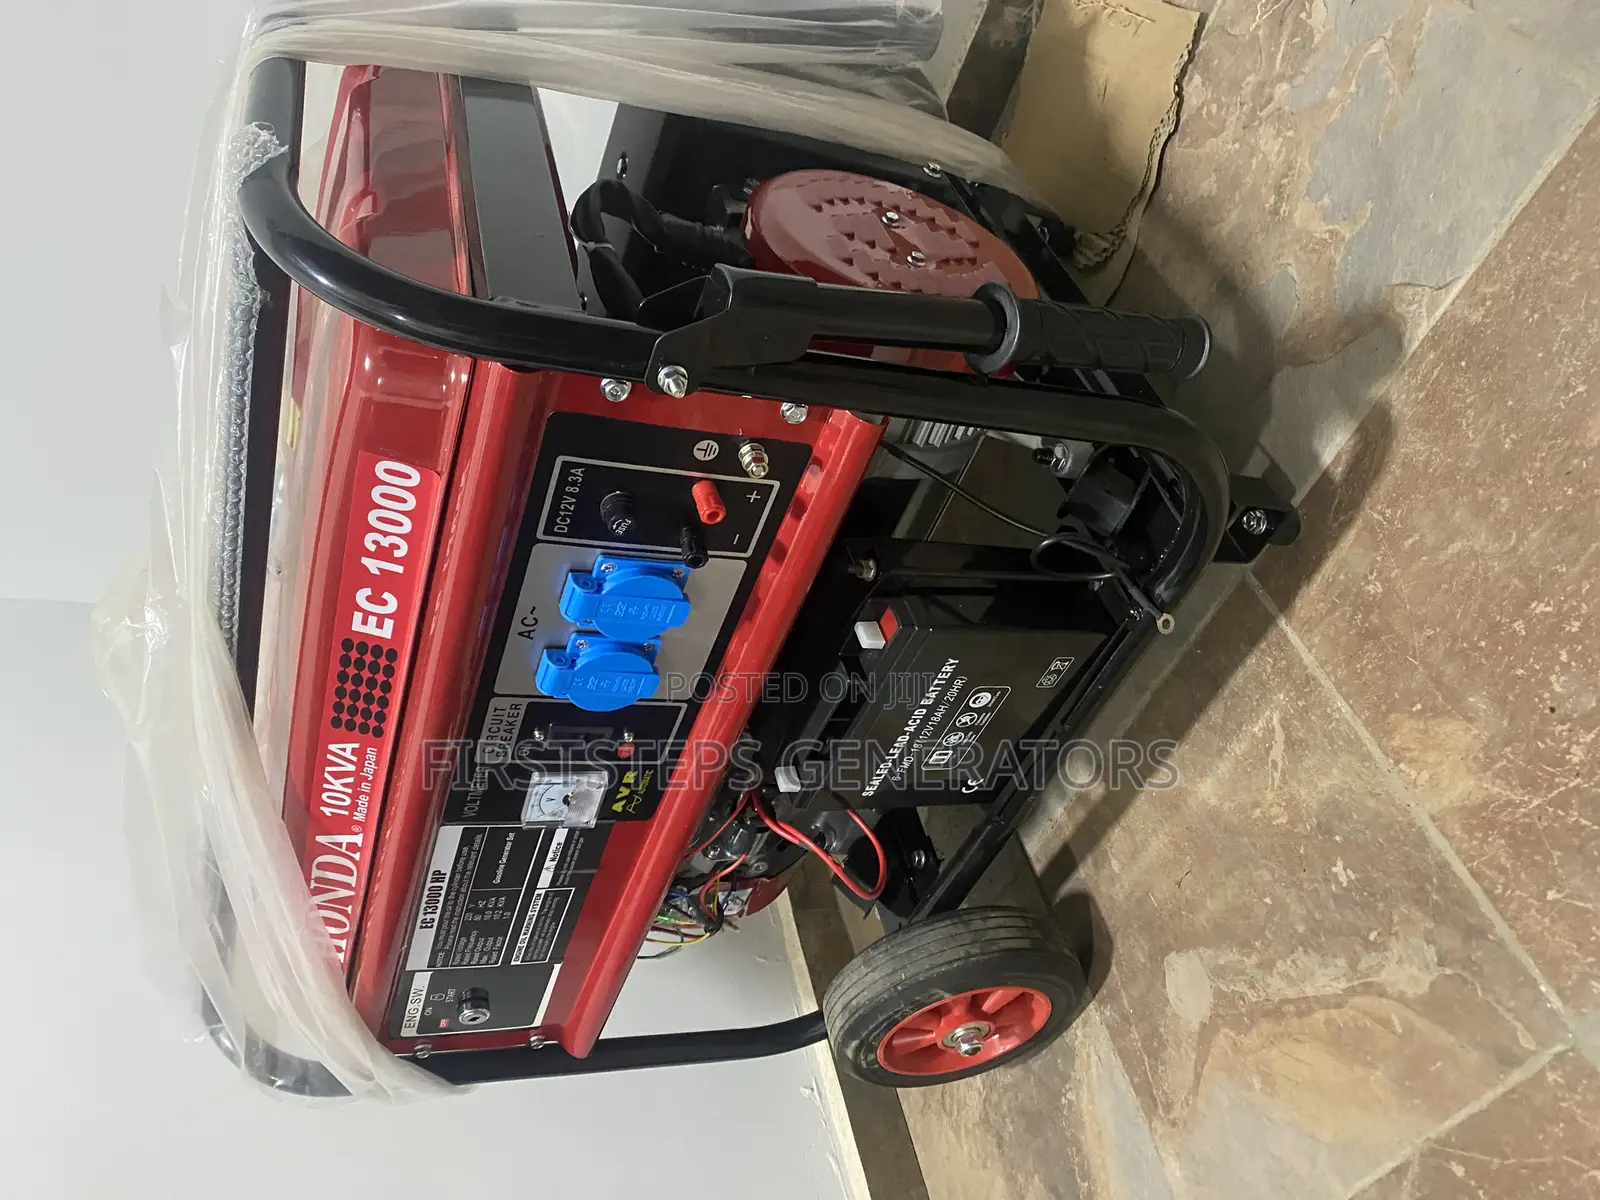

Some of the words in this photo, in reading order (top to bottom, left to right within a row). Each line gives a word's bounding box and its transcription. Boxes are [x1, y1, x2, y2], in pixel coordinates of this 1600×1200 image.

[357, 458, 422, 573] 13000
[553, 495, 576, 532] DC12V
[565, 466, 585, 492] 8.3A
[615, 518, 631, 534] FUSE
[350, 586, 399, 638] EC
[920, 658, 960, 704] BATTERY
[482, 705, 506, 754] CIRCUIT
[495, 702, 522, 757] BREAKER
[319, 742, 359, 818] 10KVA
[361, 746, 381, 780] Japan
[354, 793, 370, 821] Made
[358, 781, 372, 792] in
[611, 769, 638, 812] AVR
[492, 864, 505, 884] Gasoline
[499, 841, 512, 863] Generator
[549, 841, 562, 861] Notice
[430, 868, 447, 882] HP
[422, 884, 443, 915] 13000
[419, 915, 435, 929] EC
[404, 985, 424, 1028] ENG.SW.
[423, 1007, 432, 1015] ON
